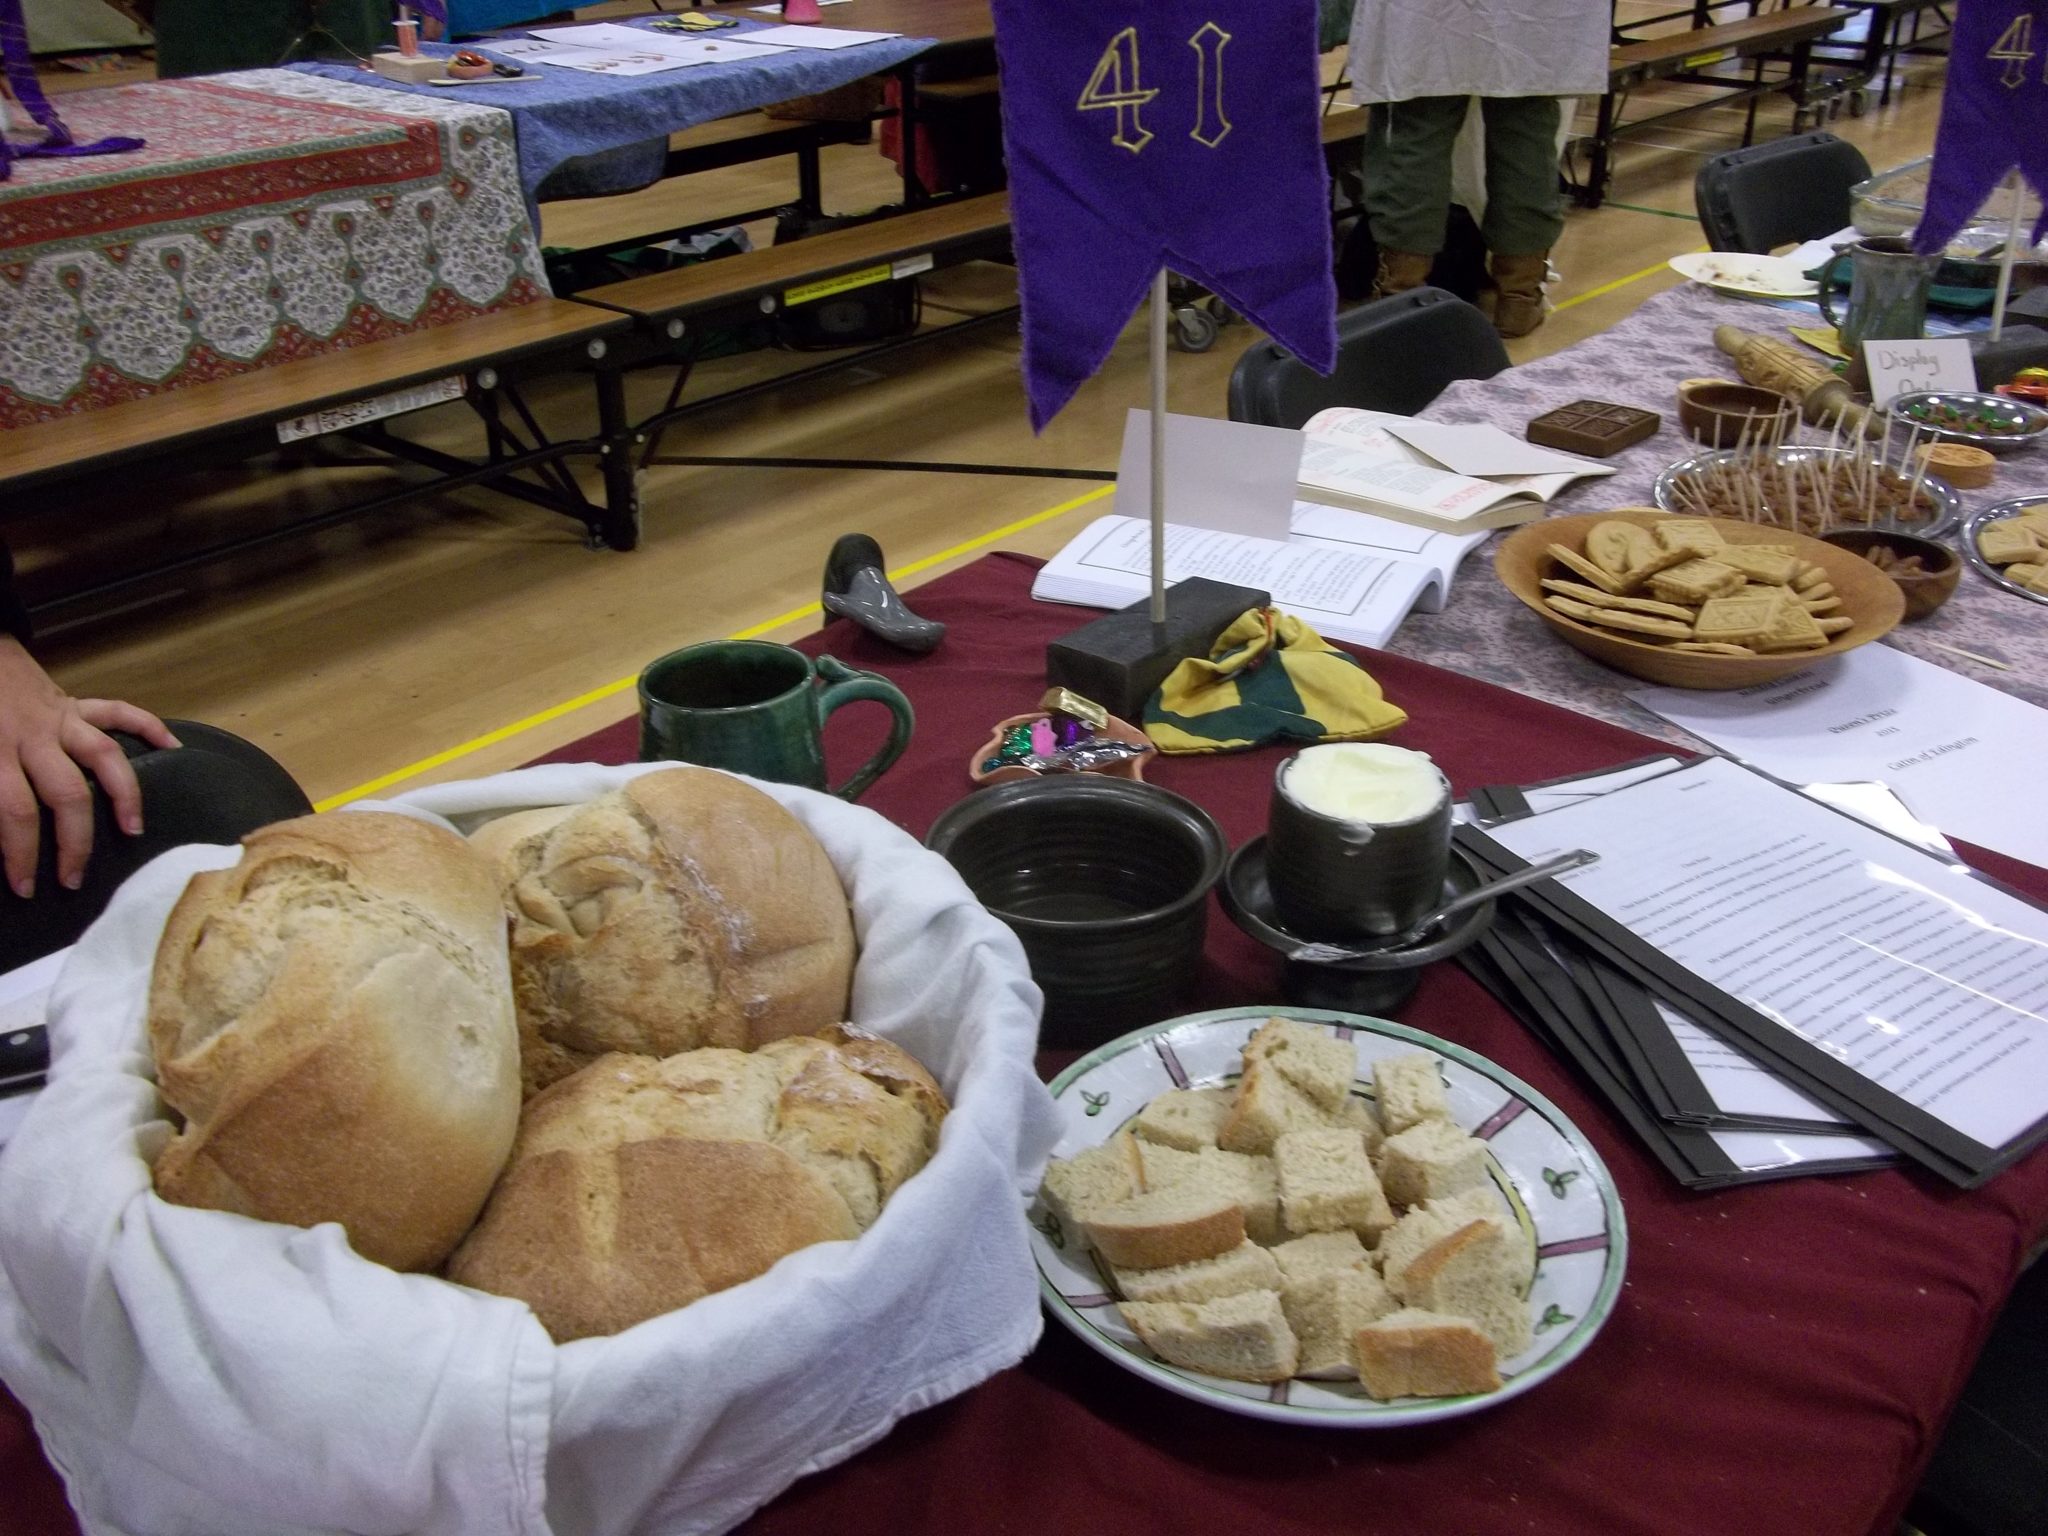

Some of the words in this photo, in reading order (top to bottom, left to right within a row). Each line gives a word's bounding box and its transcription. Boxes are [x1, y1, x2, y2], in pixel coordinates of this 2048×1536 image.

[1986, 13, 2048, 88] 4
[1880, 348, 1940, 376] Display
[1827, 717, 1869, 733] Queen's
[1866, 709, 1897, 721] Prize
